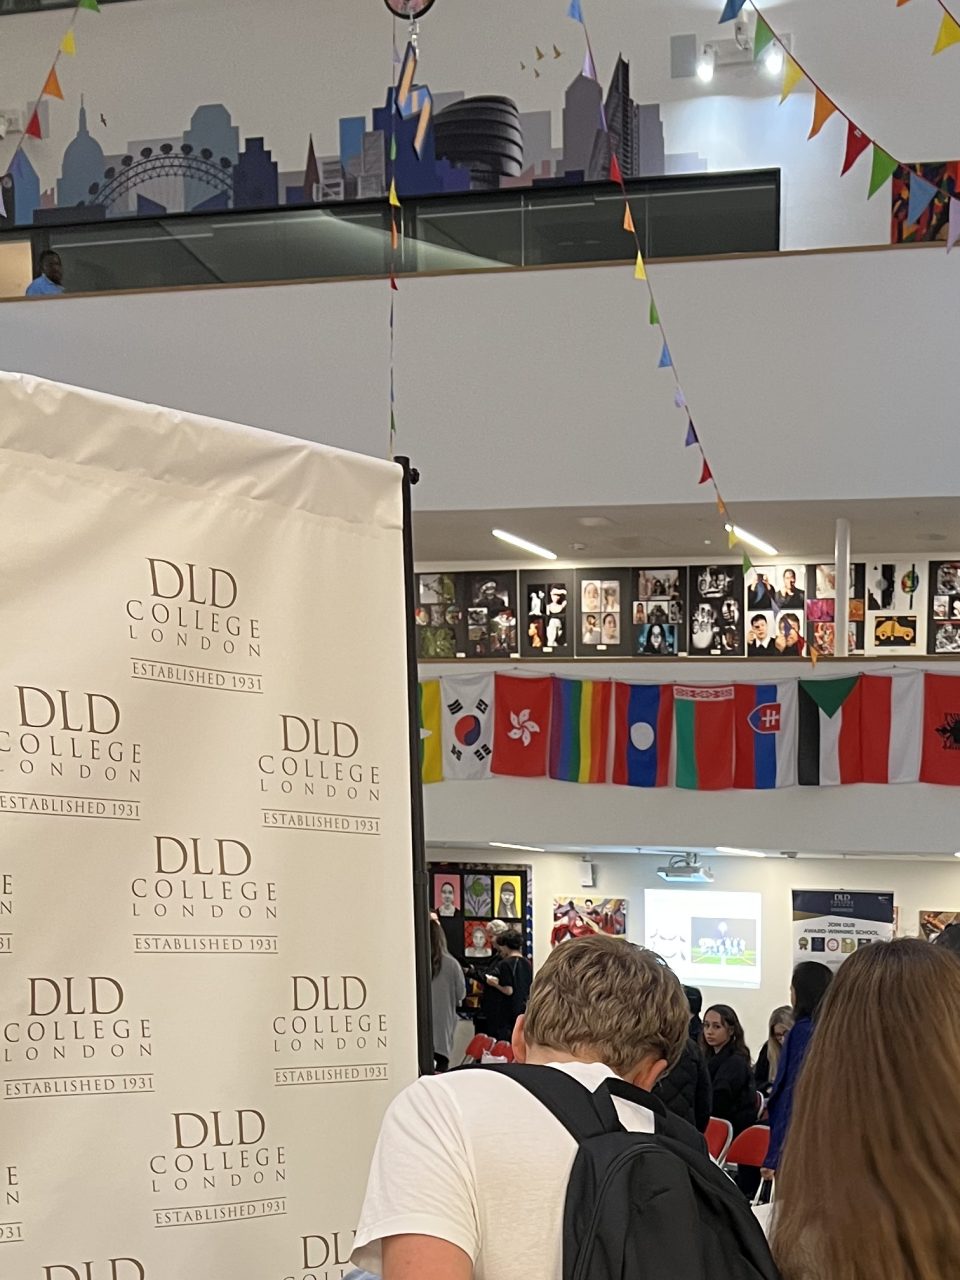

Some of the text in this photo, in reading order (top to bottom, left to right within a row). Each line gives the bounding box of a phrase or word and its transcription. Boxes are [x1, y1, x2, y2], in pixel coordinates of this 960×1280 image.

[145, 557, 237, 609] DLD
[126, 600, 260, 639] COLLEGE
[129, 625, 260, 657] LONDON
[133, 662, 261, 690] ESTABLISHED 1931
[14, 685, 120, 735] DLD
[279, 714, 359, 758] DLD
[20, 759, 140, 782] ONDON
[258, 755, 380, 784] COLLEGE
[260, 779, 379, 801] LONDON
[0, 795, 139, 817] ESTABLISHED 1931
[264, 812, 379, 832] ESTABLISHED 1931
[153, 836, 251, 876] DLD
[131, 878, 276, 901] COLLEGE
[133, 903, 277, 919] LONDON
[135, 938, 277, 950] ESTABLISHED 1931
[27, 976, 124, 1016] DLD
[291, 976, 367, 1011] DLD
[4, 1019, 151, 1043] COLLEGE
[273, 1014, 387, 1035] COLLEGE
[5, 1043, 152, 1062] LONDON
[274, 1036, 387, 1052] LONDON
[6, 1077, 152, 1096] ESTABLISHED 1931
[276, 1067, 386, 1082] ESTABLISHED 1931
[171, 1109, 265, 1149] DLD
[150, 1146, 285, 1174] COLLEGE
[152, 1169, 285, 1192] LONDON
[156, 1200, 285, 1224] ESTABLISHED 1931
[300, 1229, 357, 1270] DL
